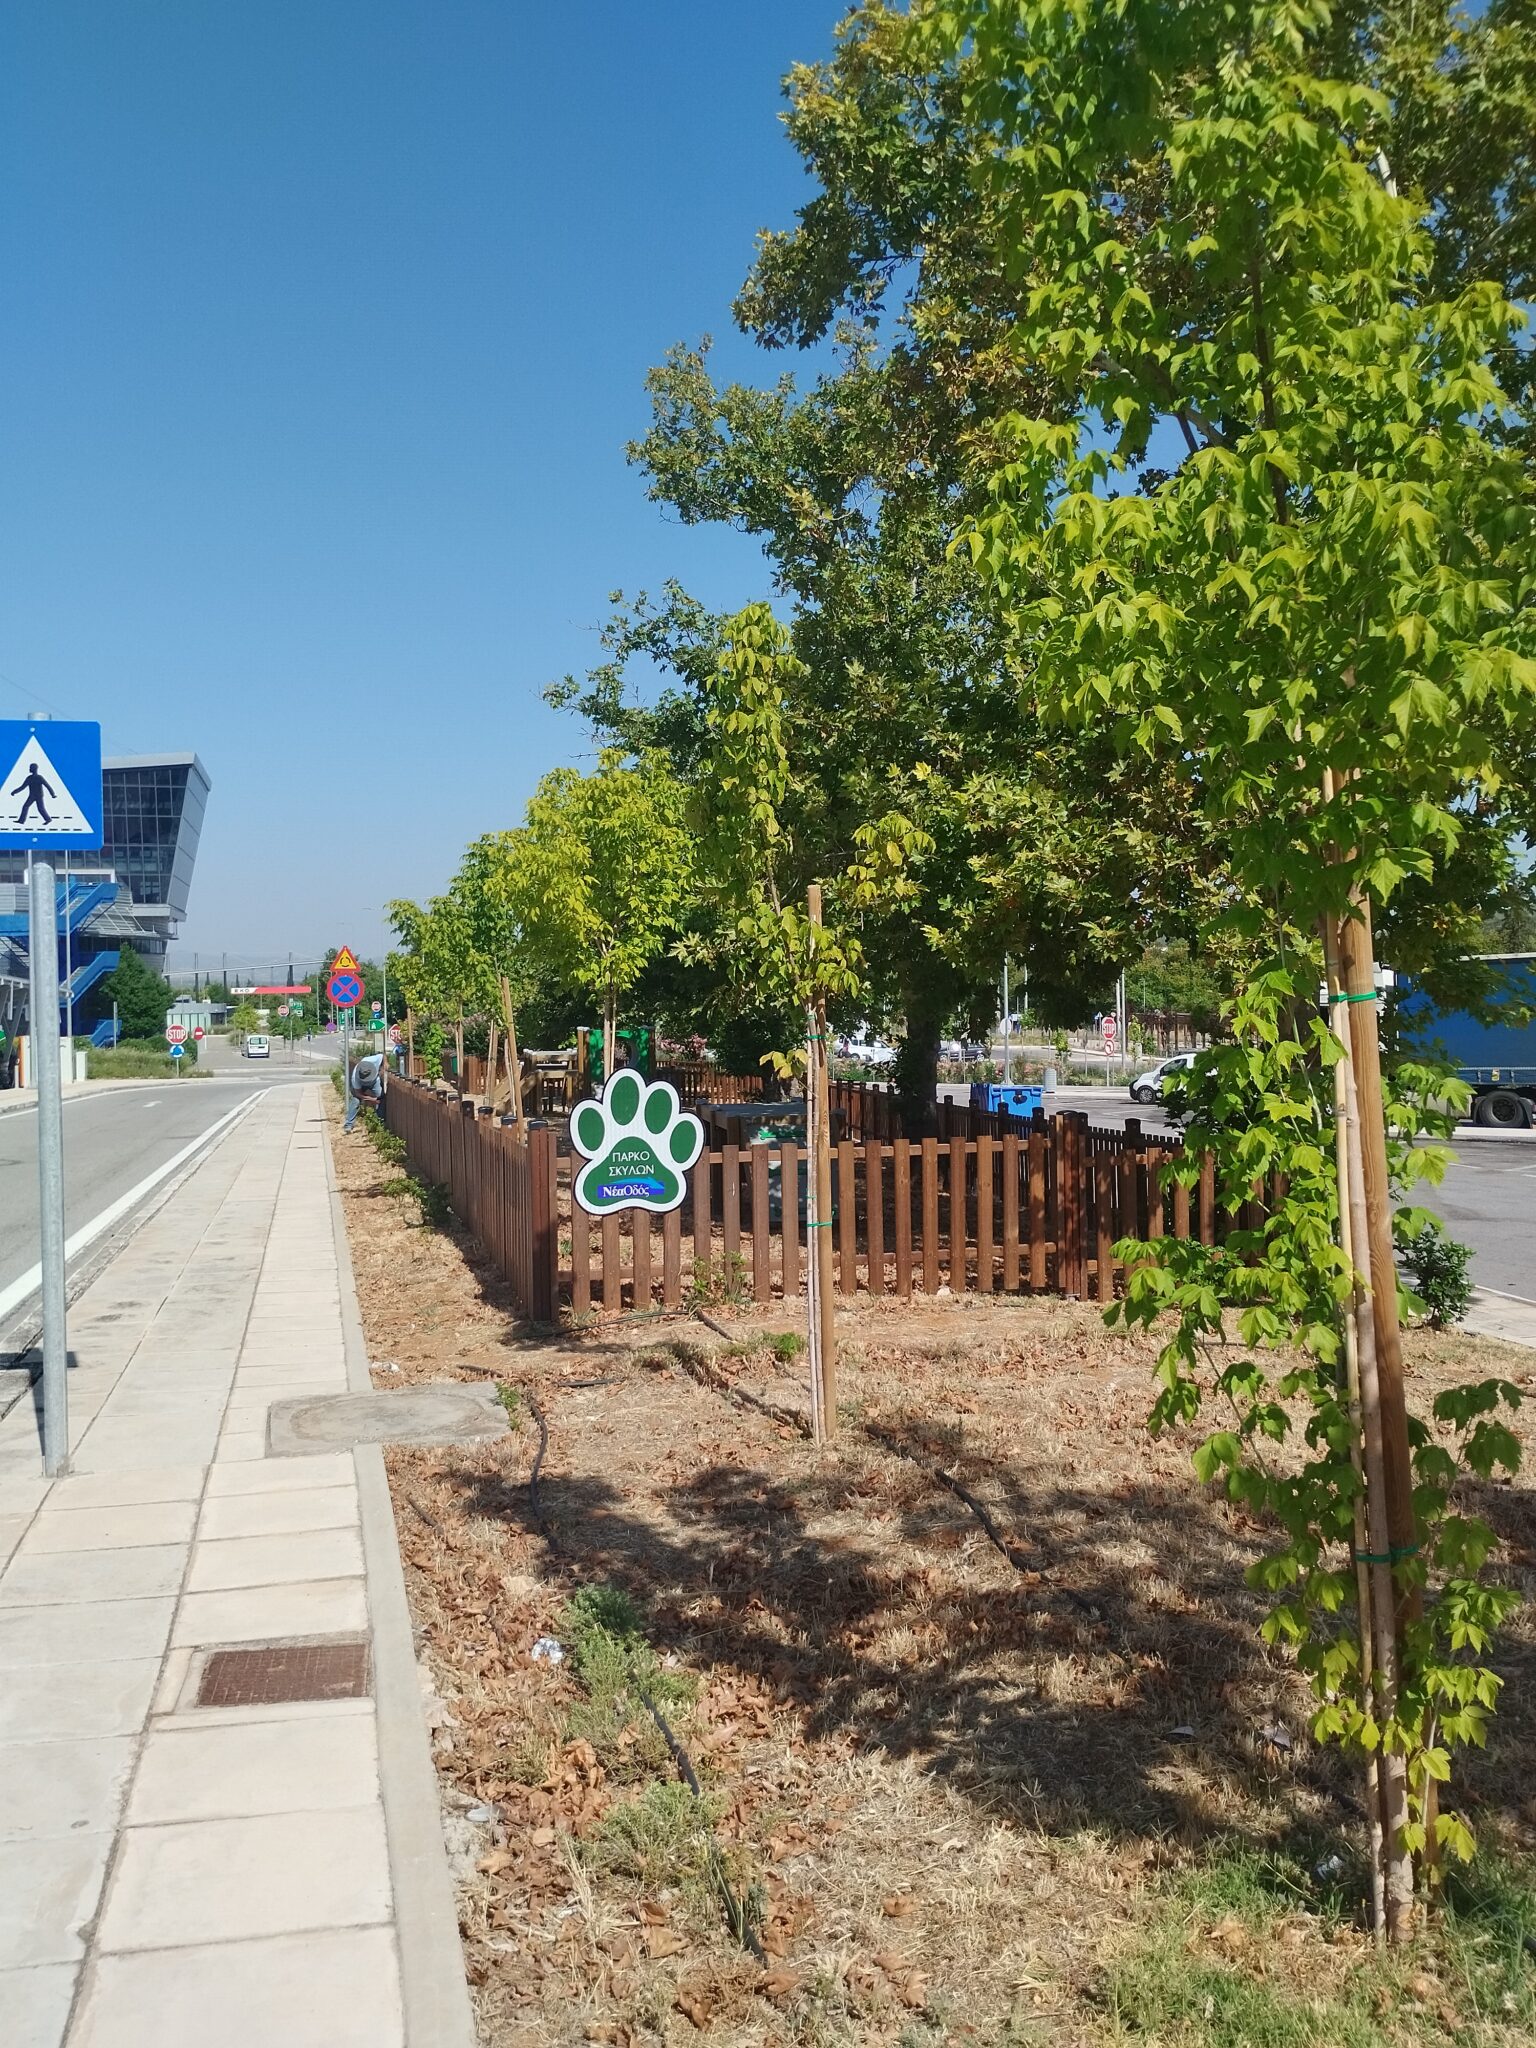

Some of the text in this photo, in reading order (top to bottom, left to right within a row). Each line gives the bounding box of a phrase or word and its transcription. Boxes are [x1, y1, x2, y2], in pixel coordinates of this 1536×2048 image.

[168, 1029, 186, 1040] STOP
[1103, 1023, 1116, 1035] STOP
[612, 1150, 650, 1163] ΠΑΡΚΟ
[608, 1164, 655, 1177] ΣΚΥΛΩΝ
